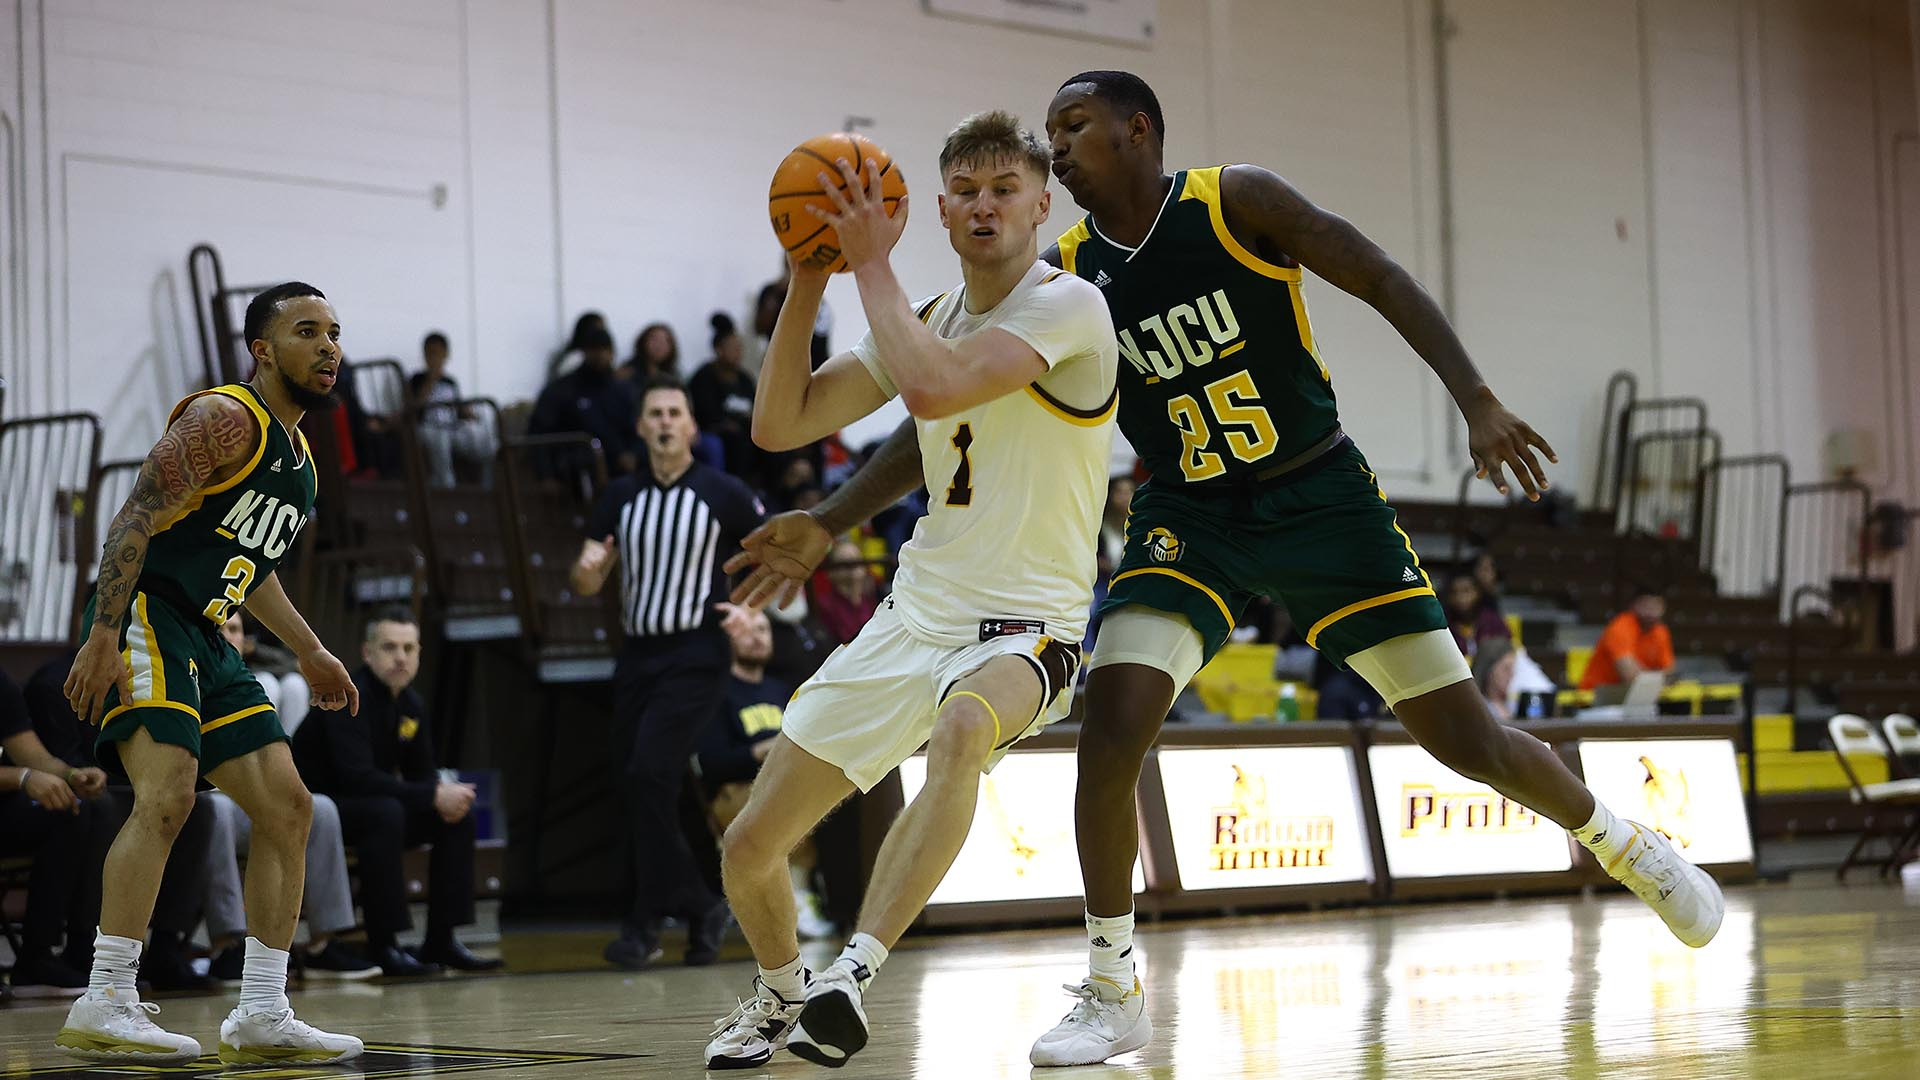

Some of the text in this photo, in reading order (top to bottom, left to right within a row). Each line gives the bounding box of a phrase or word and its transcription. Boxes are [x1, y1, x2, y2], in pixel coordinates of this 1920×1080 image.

[1118, 289, 1240, 380] NJCU
[945, 421, 974, 508] 1
[1167, 369, 1279, 482] 25
[203, 555, 257, 626] 3
